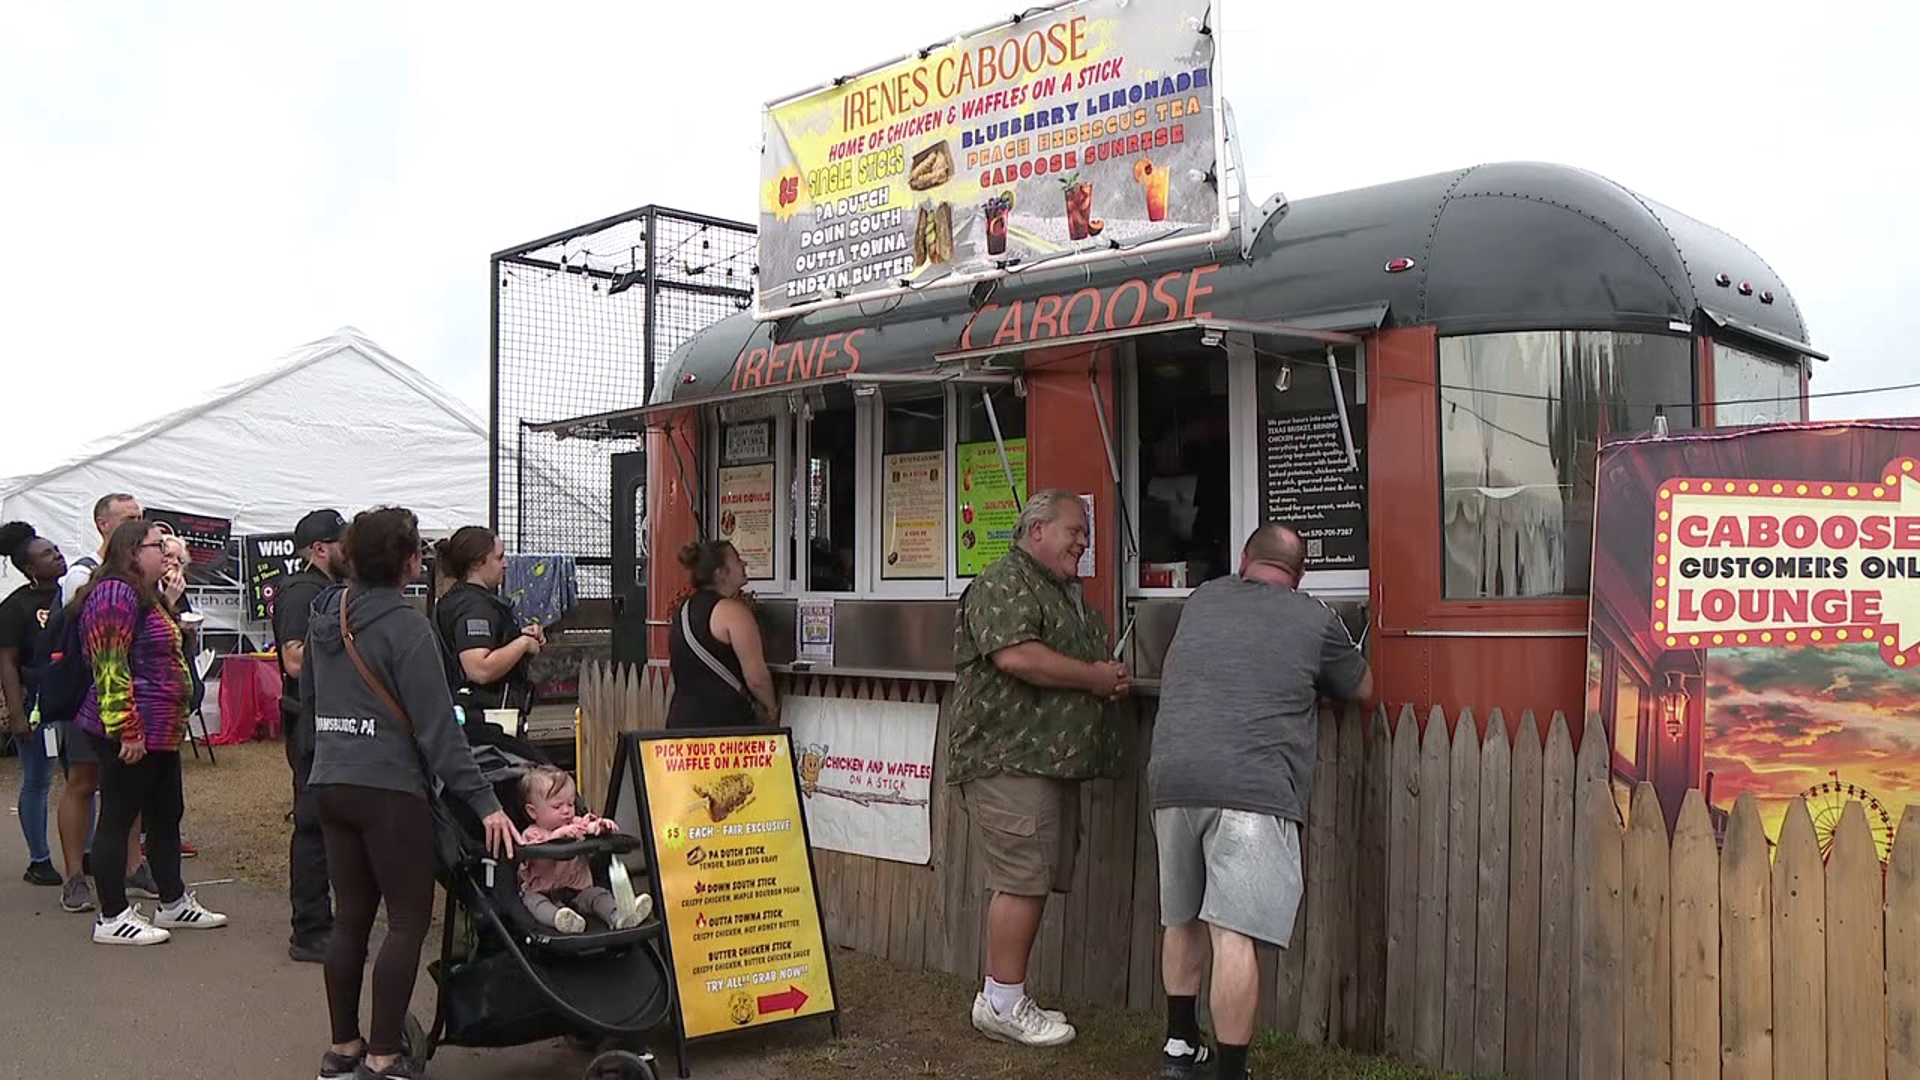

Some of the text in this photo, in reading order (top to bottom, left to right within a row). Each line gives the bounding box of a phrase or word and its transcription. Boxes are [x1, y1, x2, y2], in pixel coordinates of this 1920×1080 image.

[842, 15, 1088, 132] IRENES CABOOSE
[828, 57, 1124, 162] HOME OF CHICKEN & WAFFLES ON A STICK
[961, 68, 1209, 149] BLUEBERRY LEMONADE
[967, 95, 1201, 169] PEACH HIBISCUS TEA
[980, 124, 1184, 188] CABOOSE SUNRISE
[808, 144, 905, 198] SINGLE STICKS
[779, 176, 799, 208] $5
[815, 185, 889, 223] PA DUTCH
[801, 208, 901, 249] DOWN SOUTH
[795, 231, 907, 273] OUTTA TOWNA
[786, 255, 914, 298] INDIAN BUTTER
[731, 262, 1221, 392] IRENES CABOOSE
[1267, 432, 1336, 443] CHICKEN and preparing
[1268, 426, 1286, 434] TEXAS
[1268, 444, 1298, 453] everything
[1315, 466, 1336, 474] chicken
[1303, 484, 1324, 493] loaded
[1277, 513, 1307, 522] workplace
[1677, 515, 1920, 550] CABOOSE
[257, 539, 295, 557] WHO
[1311, 557, 1325, 565] your
[1325, 554, 1356, 564] feedback!
[1679, 556, 1848, 579] CUSTOMERS
[254, 586, 261, 600] 1
[257, 604, 265, 617] 2
[1677, 588, 1883, 625] LOUNGE
[360, 719, 375, 736] PA
[655, 740, 777, 758] PICK YOUR CHICKEN &
[665, 754, 773, 772] WAFFLE ON A STICK
[825, 756, 931, 779] CHICKEN AND WAFFLES
[849, 774, 906, 790] ON A STICK
[667, 827, 680, 839] $5
[689, 827, 714, 840] EACH
[722, 824, 744, 836] FAIR
[746, 819, 791, 834] EXCLUSIVE
[700, 855, 778, 870] TENDER, BAKED AND GRAVY
[708, 846, 766, 860] PA DUTCH STICK
[707, 877, 777, 893] DOWN SOUTH STICK
[681, 897, 703, 908] CRISPY
[704, 894, 732, 905] CHICKEN,
[733, 891, 754, 901] MAPLE
[755, 887, 782, 899] BOURBON
[708, 909, 783, 928] OUTTA TOWNA STICK
[692, 931, 714, 941] CRISPY
[744, 925, 757, 934] HOT
[758, 922, 778, 932] HONEY
[779, 919, 800, 929] BUTTER
[708, 940, 792, 961] BUTTER CHICKEN STICK
[692, 964, 714, 975] CRISPY
[744, 956, 766, 966] BUTTER
[767, 952, 792, 963] CHICKEN
[792, 949, 811, 959] SAUCE
[706, 979, 724, 993] TRY
[727, 974, 750, 989] ALL!!
[752, 970, 777, 985] GRAB
